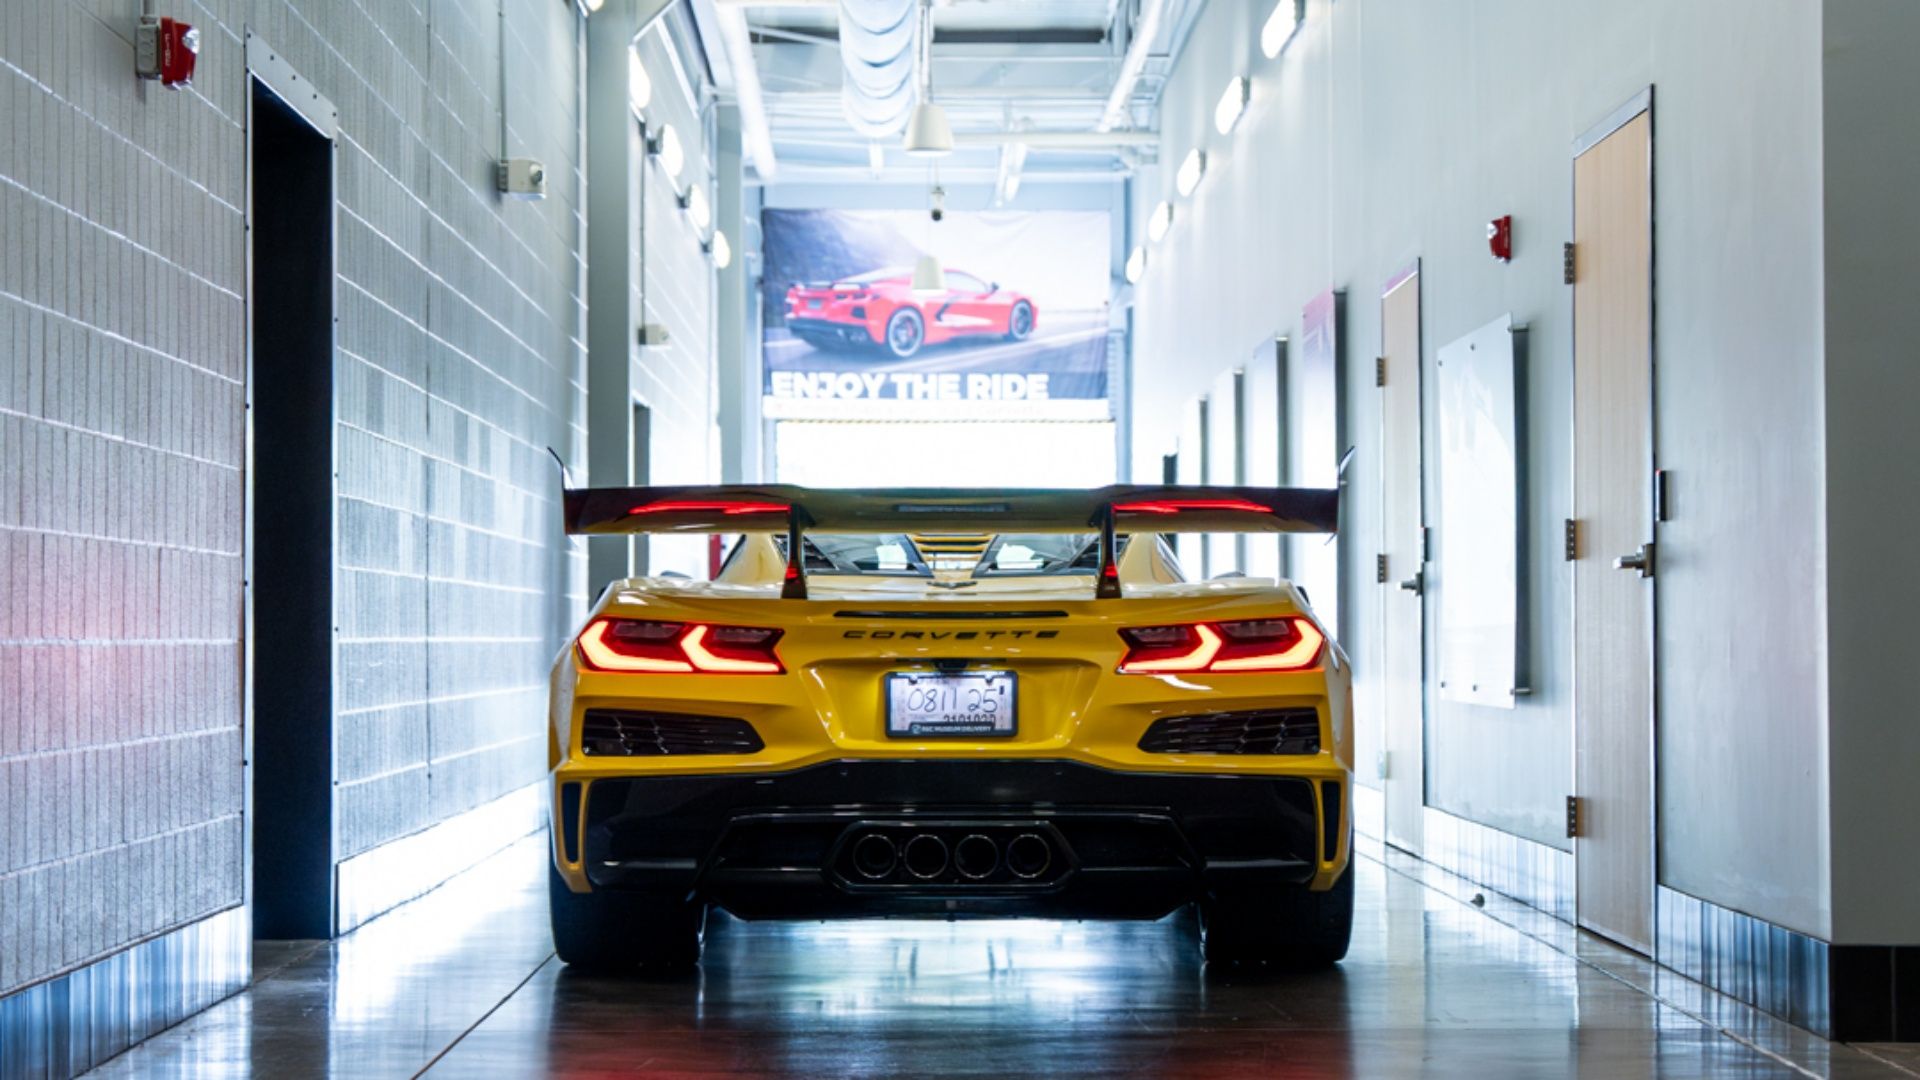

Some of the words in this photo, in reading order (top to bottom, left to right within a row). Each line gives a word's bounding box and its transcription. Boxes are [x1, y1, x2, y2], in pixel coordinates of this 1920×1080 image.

[771, 372, 886, 399] ENJOY
[891, 373, 960, 399] THE
[967, 374, 1049, 399] RIDE
[843, 630, 1060, 640] CORVETTE
[908, 688, 957, 712] 0811
[968, 688, 998, 712] 25
